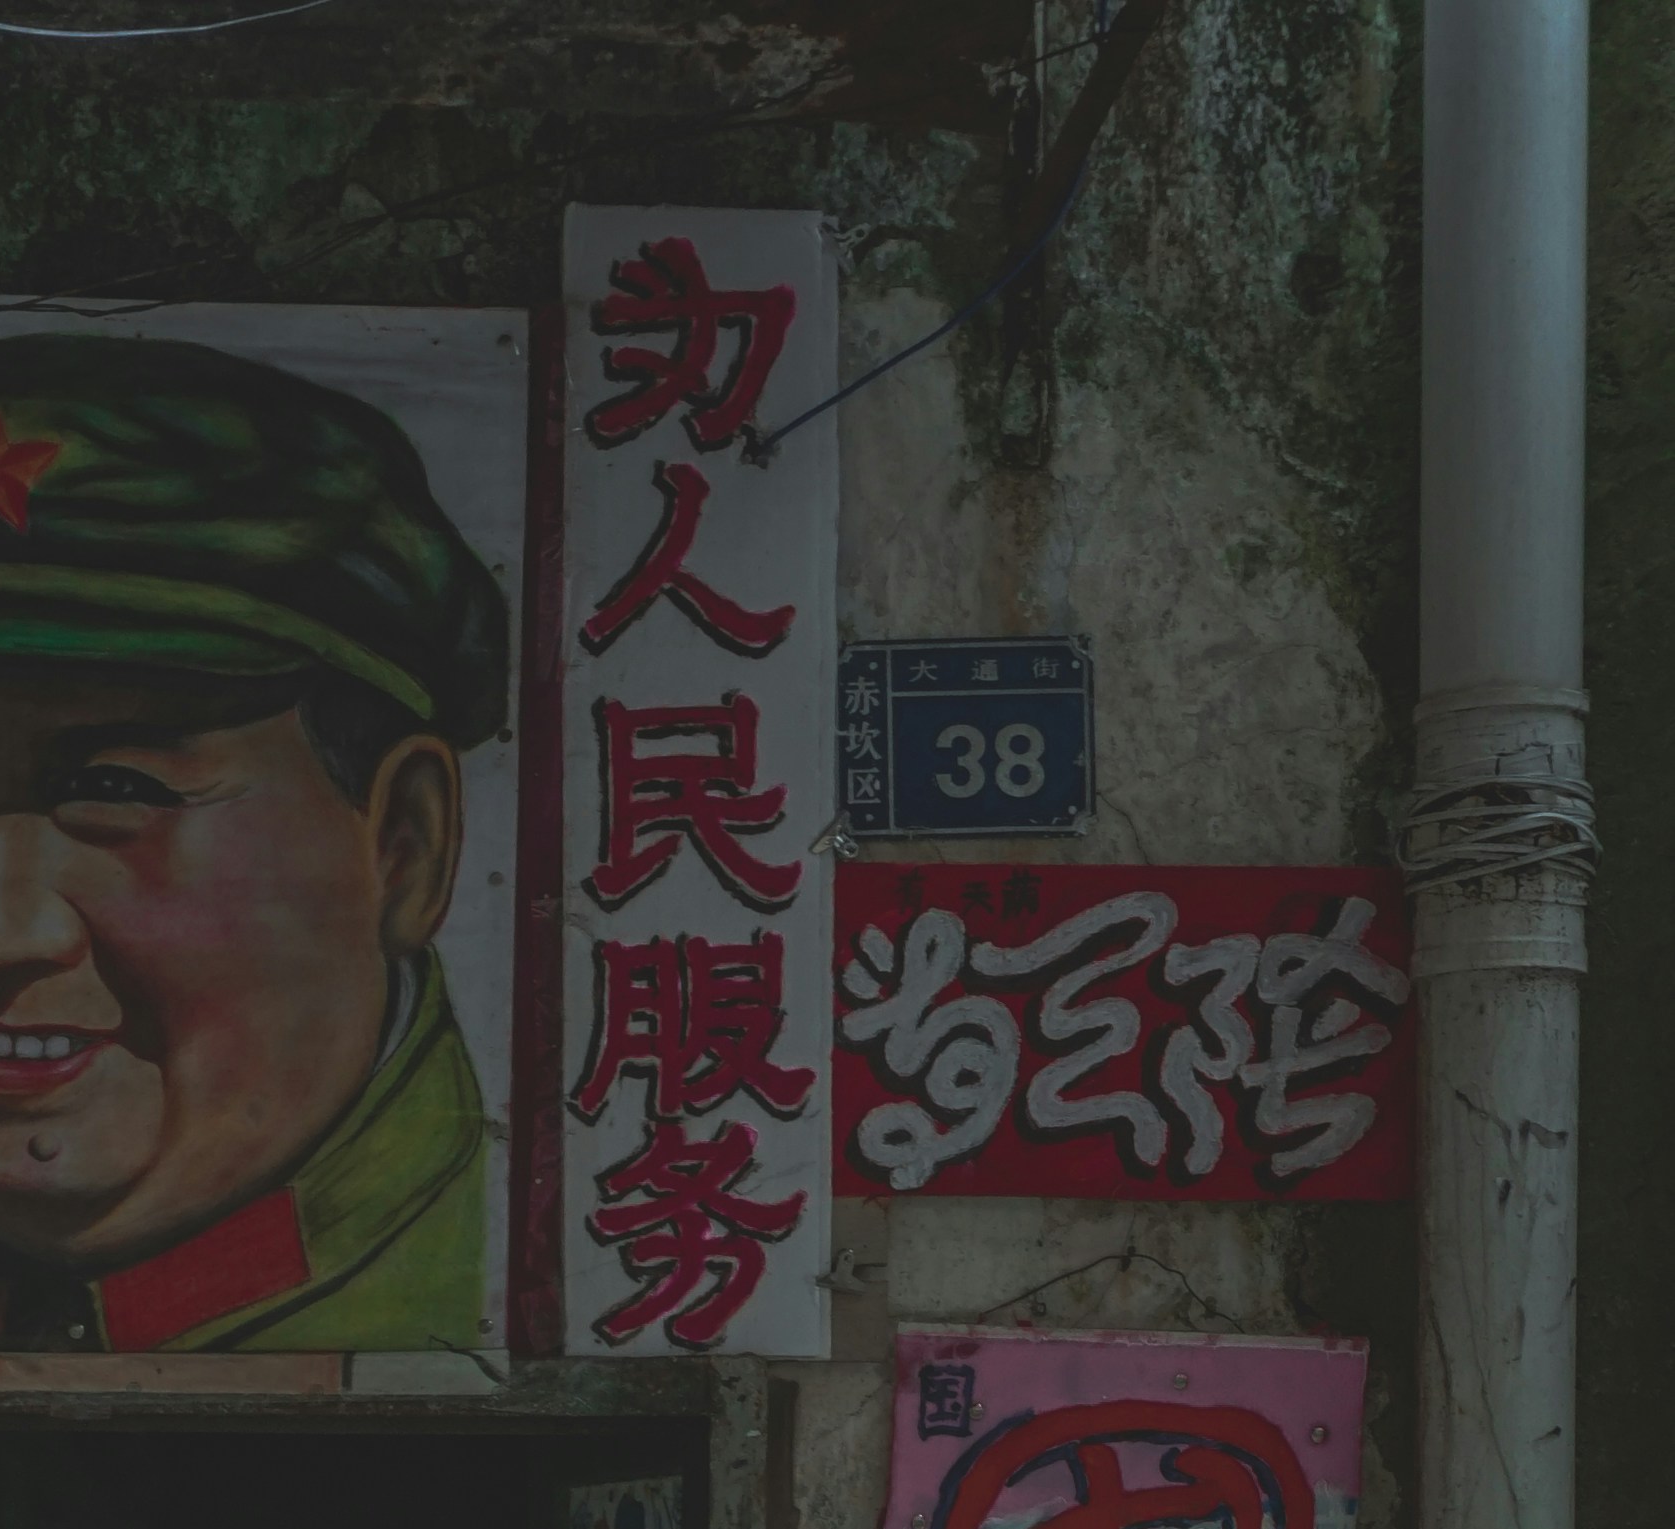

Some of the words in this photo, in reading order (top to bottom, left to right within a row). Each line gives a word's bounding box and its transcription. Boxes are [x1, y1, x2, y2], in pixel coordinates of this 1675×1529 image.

[909, 657, 1060, 683] 大通街
[843, 676, 882, 806] 赤坎区
[934, 723, 1046, 799] 38
